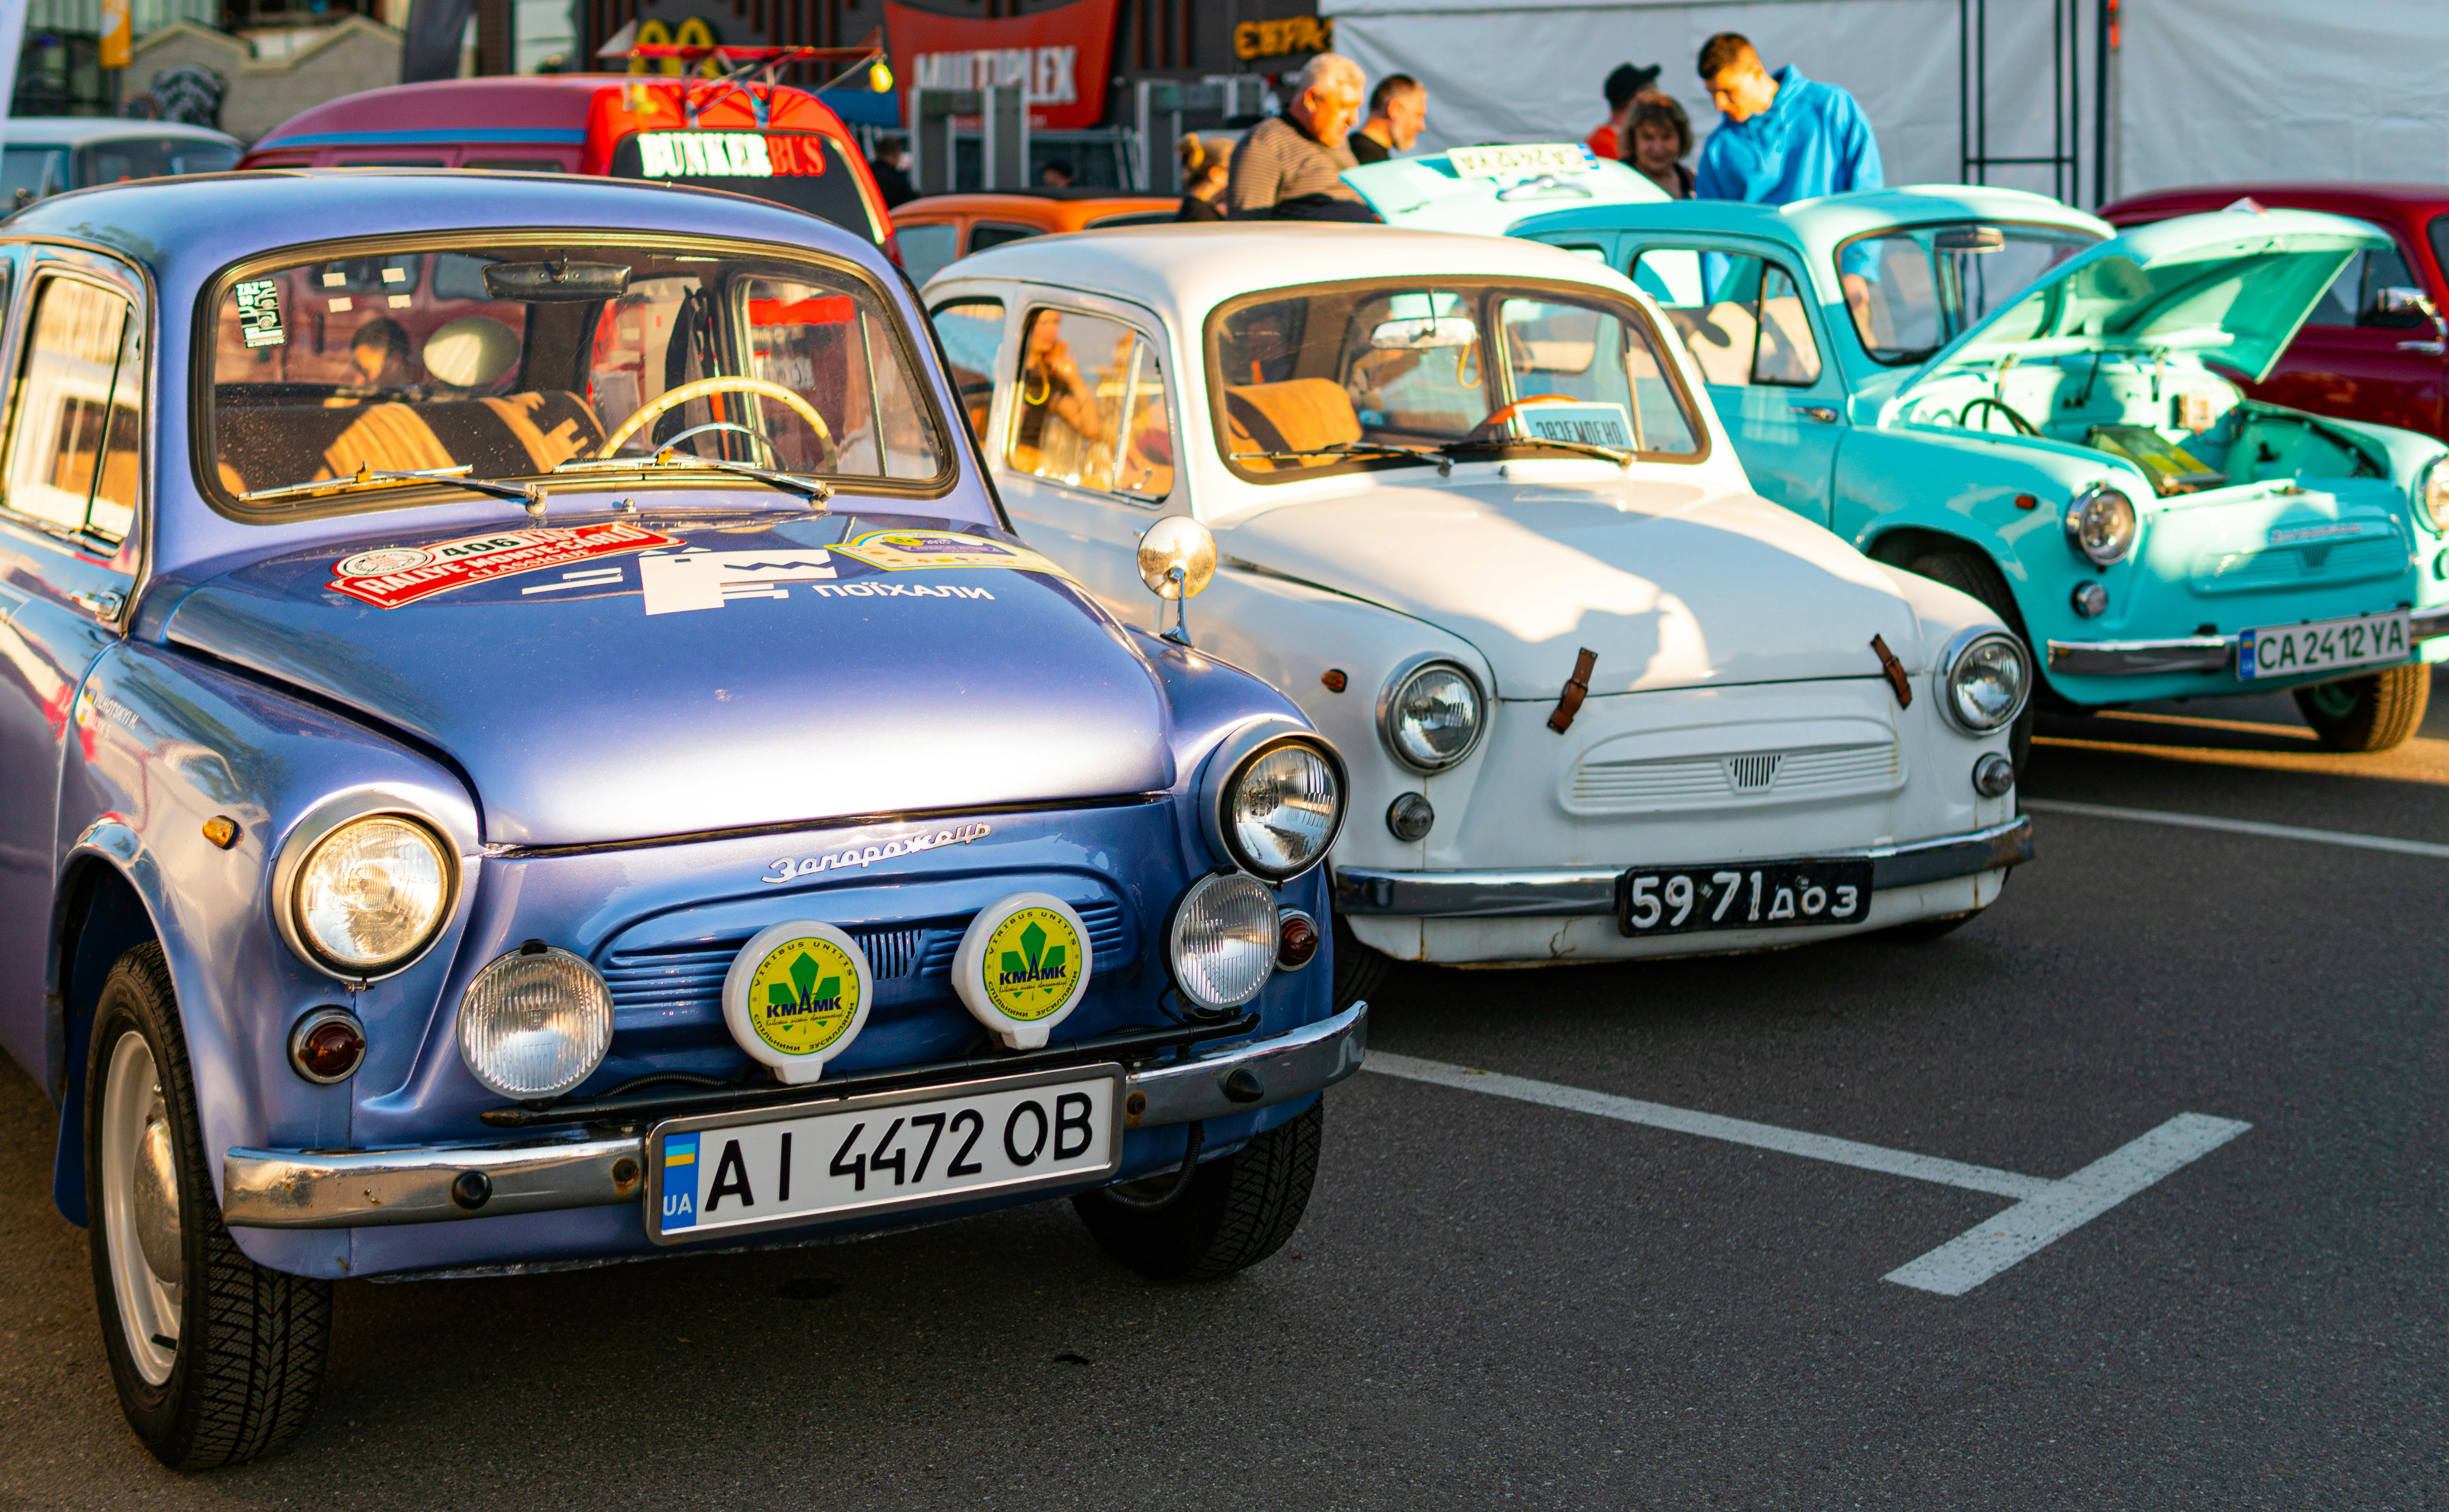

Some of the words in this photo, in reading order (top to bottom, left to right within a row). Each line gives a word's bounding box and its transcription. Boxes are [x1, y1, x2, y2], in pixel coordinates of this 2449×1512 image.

[236, 282, 260, 296] ZAZ
[353, 562, 469, 595] RALLYE
[464, 527, 651, 568] MONTE-CARLO
[442, 538, 521, 557] 406
[811, 582, 995, 600] ПОЇХАЛИ
[2258, 633, 2297, 670] CA
[2303, 624, 2365, 664] 2412
[2371, 617, 2405, 655] YA
[989, 912, 1033, 955] VIRIBUS
[1041, 912, 1076, 946] UNITIS
[755, 941, 804, 987] VIRIBUS
[813, 941, 853, 977] UNITIS
[988, 981, 1028, 1017] СПІЛЬНИМИ
[1036, 971, 1078, 1016] ЗУСИЛЛЯМИ
[754, 1014, 800, 1051] СПІЛЬНИМИ
[809, 1002, 855, 1050] ЗУСИЛЛЯМИ
[704, 1131, 793, 1212] AI
[829, 1108, 984, 1192] 4472
[1003, 1092, 1093, 1167] OB
[663, 1192, 693, 1217] UA
